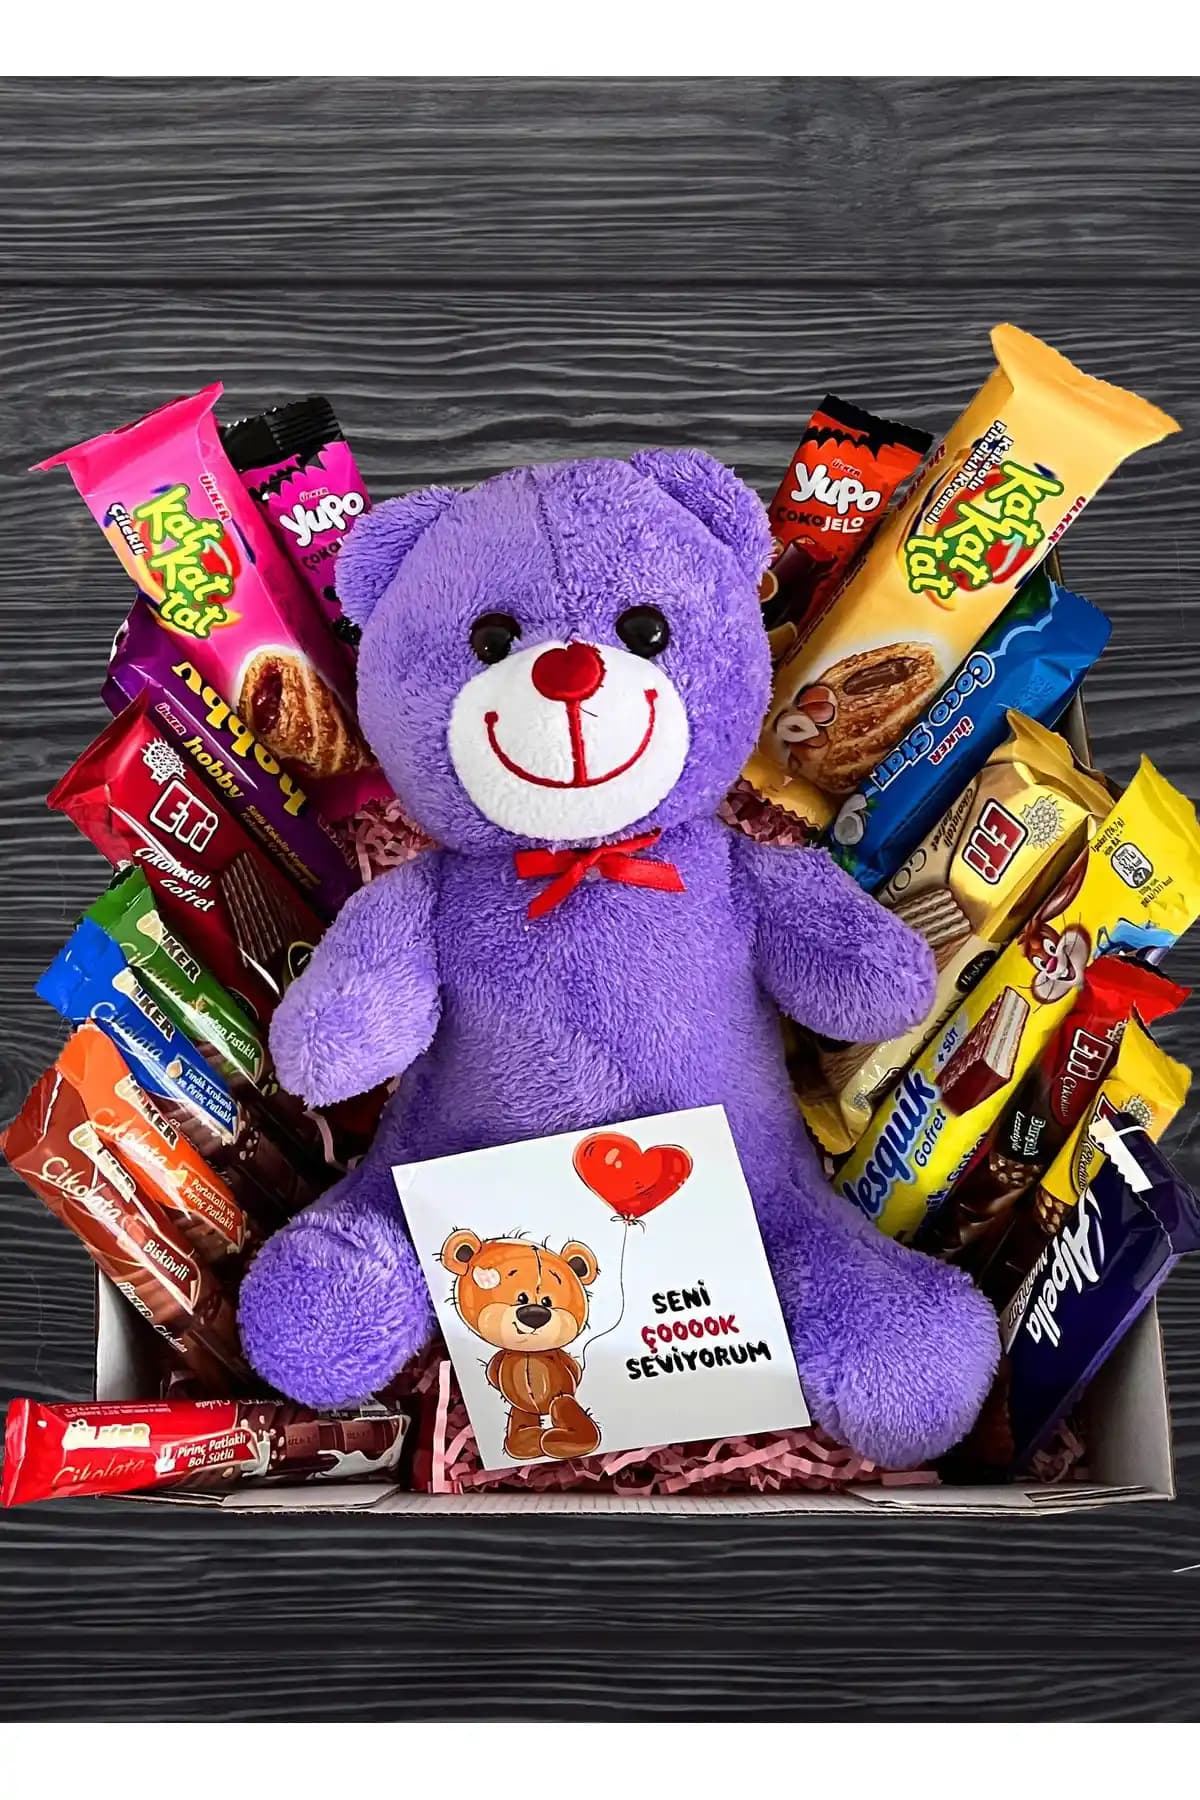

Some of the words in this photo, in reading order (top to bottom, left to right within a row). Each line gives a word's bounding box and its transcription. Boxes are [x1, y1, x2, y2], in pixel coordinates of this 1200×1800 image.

[964, 420, 1008, 472] Fındıklı
[967, 436, 1014, 491] Kakaolu
[199, 473, 232, 521] ÜLKER
[925, 470, 969, 525] Kremalı
[108, 503, 147, 556] Çilekli
[929, 651, 995, 726] Coco
[870, 721, 934, 791] Star
[928, 716, 974, 766] ÜLKER
[182, 736, 244, 798] hobby
[160, 879, 216, 912] Gofret
[137, 911, 201, 984] LKER
[112, 967, 176, 1042] LKER
[226, 1031, 256, 1060] Fıstıklı
[943, 1026, 960, 1054] SÜT
[914, 1108, 947, 1167] Gofret
[192, 1178, 227, 1211] Portakallı
[226, 1206, 236, 1219] ve
[205, 1204, 234, 1231] Patlaklı
[144, 1239, 190, 1281] Bisküvili
[1026, 1193, 1100, 1347] Alpella
[652, 1279, 711, 1314] SENİ
[641, 1314, 740, 1354] ÇOOOOK
[625, 1340, 772, 1380] SEVİYORUM
[178, 1443, 206, 1458] Pirinç
[208, 1432, 246, 1449] Patlaklı
[188, 1454, 205, 1468] Bol
[207, 1447, 234, 1463] Sütlü
